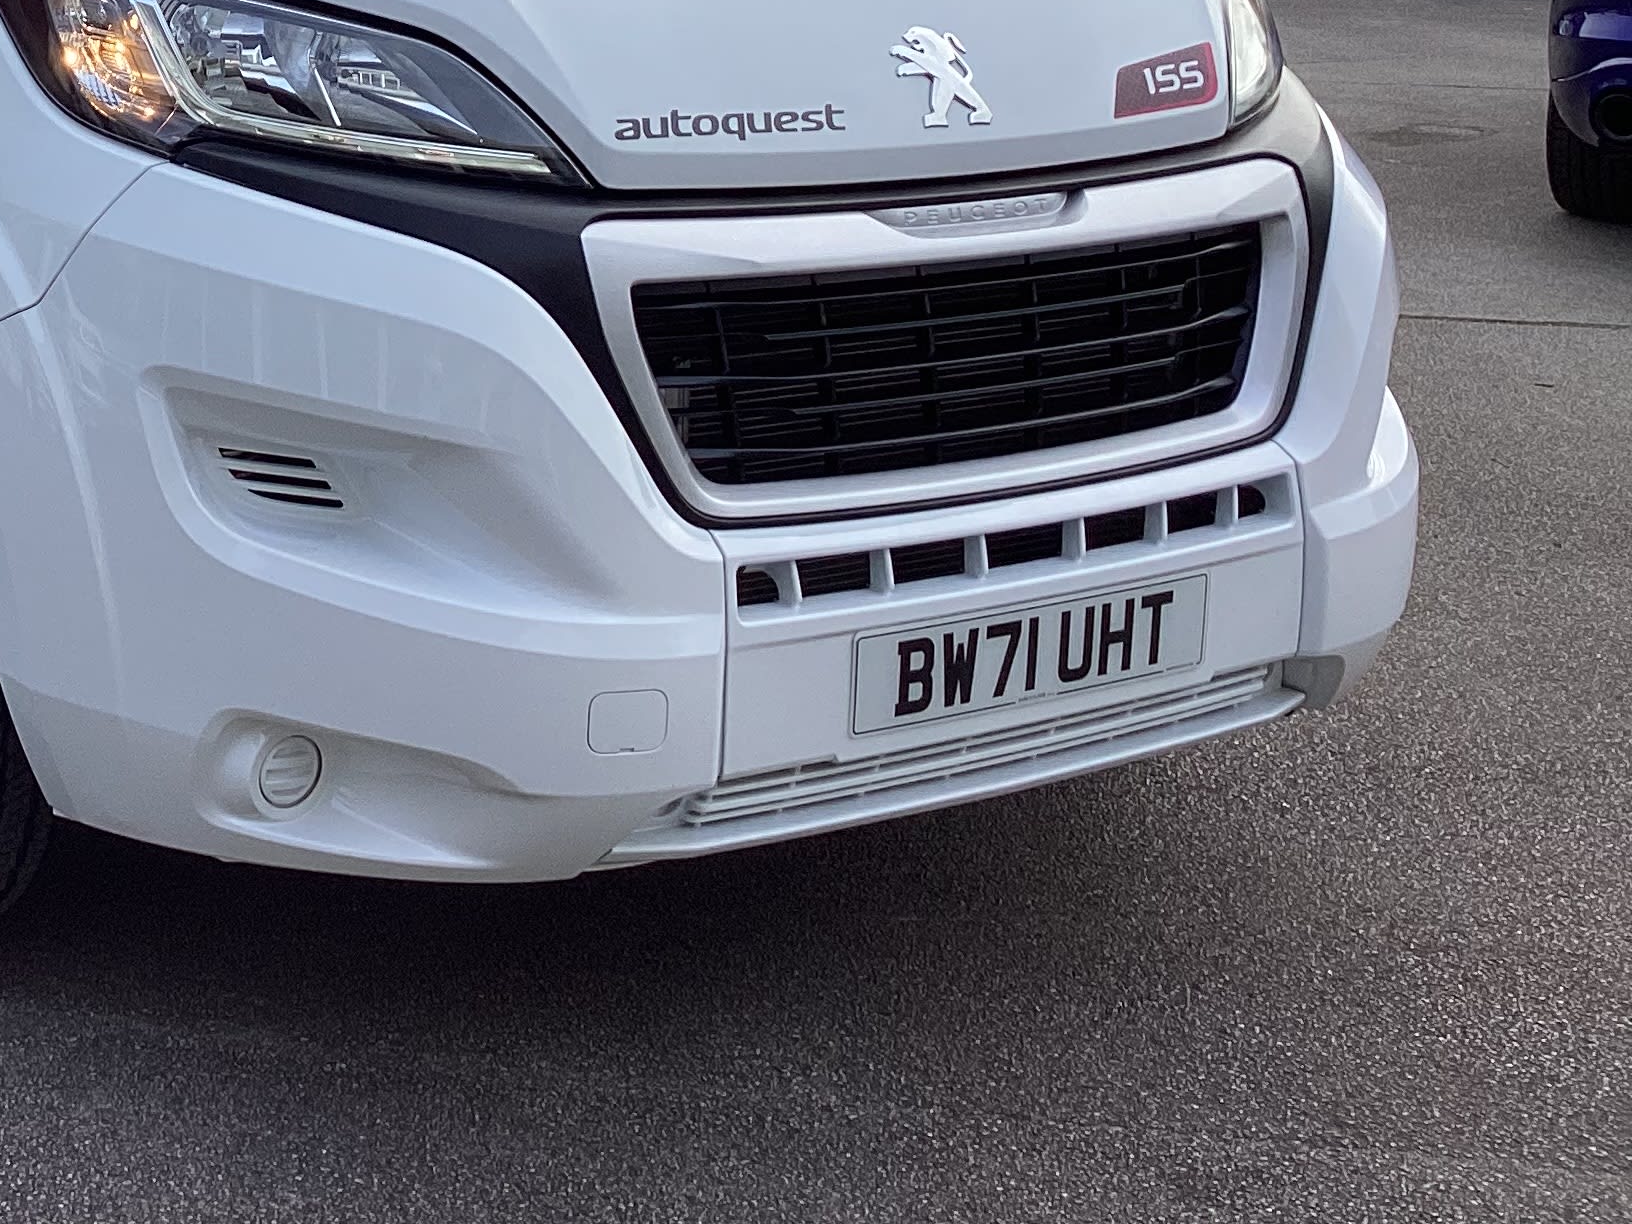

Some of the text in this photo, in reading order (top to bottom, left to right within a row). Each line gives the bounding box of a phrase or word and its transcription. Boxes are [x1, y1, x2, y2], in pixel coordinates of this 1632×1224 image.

[1143, 60, 1204, 95] 155
[614, 103, 847, 141] autoquest
[904, 197, 1049, 225] PEUGEOT
[894, 591, 1175, 718] BW71 UHT
